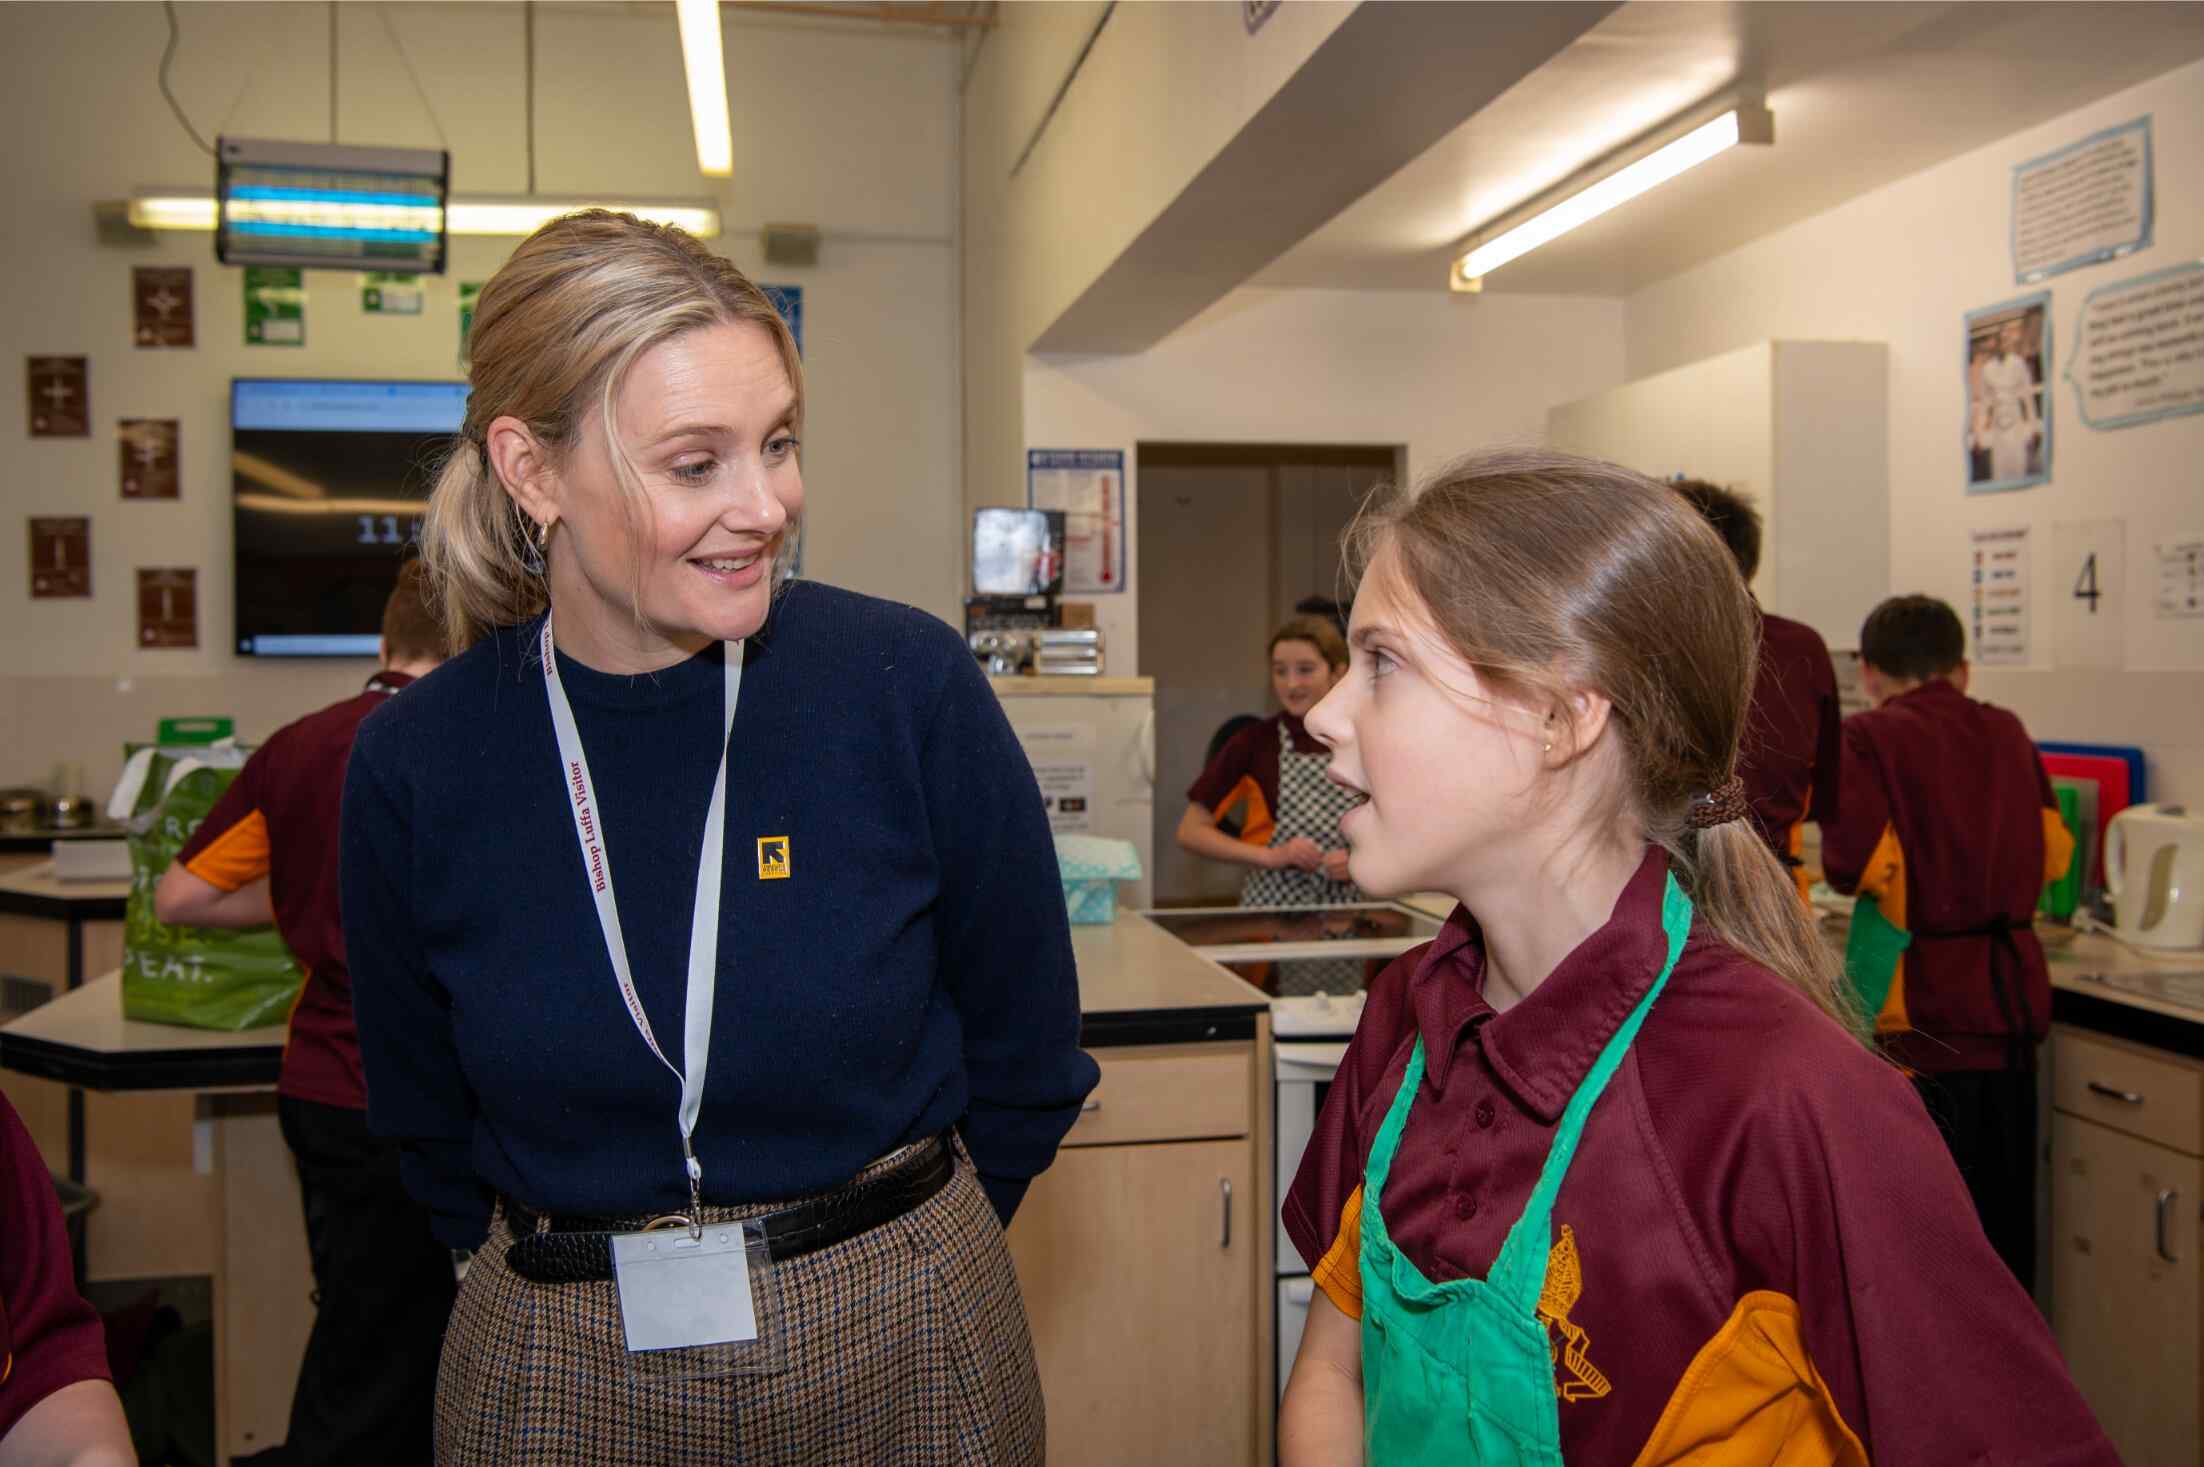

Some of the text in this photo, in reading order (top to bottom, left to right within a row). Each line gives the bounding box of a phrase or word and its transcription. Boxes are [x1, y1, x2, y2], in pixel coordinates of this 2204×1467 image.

[2074, 553, 2101, 613] 4
[571, 761, 606, 892] Bishop Luffa Visitor
